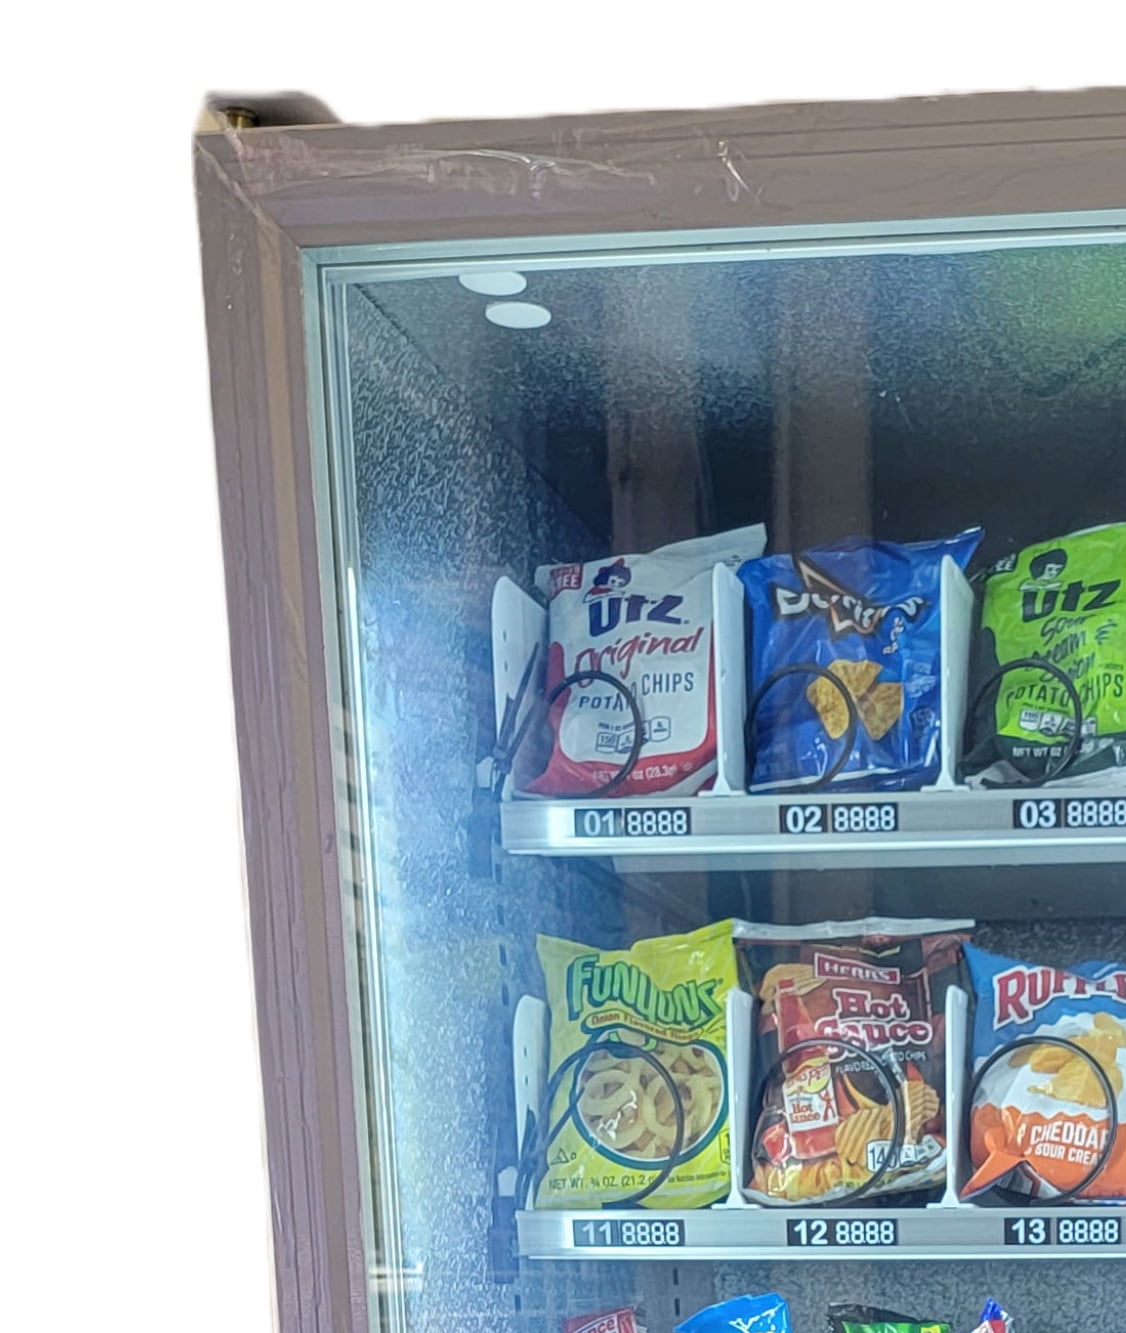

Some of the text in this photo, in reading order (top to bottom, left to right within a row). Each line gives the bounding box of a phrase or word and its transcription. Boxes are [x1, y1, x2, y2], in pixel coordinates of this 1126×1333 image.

[575, 626, 703, 688] Original
[642, 671, 694, 697] CHIPS
[584, 812, 614, 834] 01
[786, 807, 822, 831] 02
[1020, 802, 1056, 827] 03
[834, 989, 909, 1019] Hot
[815, 1015, 933, 1061] Sauce
[1035, 1145, 1065, 1160] SOUR
[583, 1223, 611, 1244] 11
[794, 1221, 827, 1243] 12
[1012, 1219, 1045, 1242] 13
